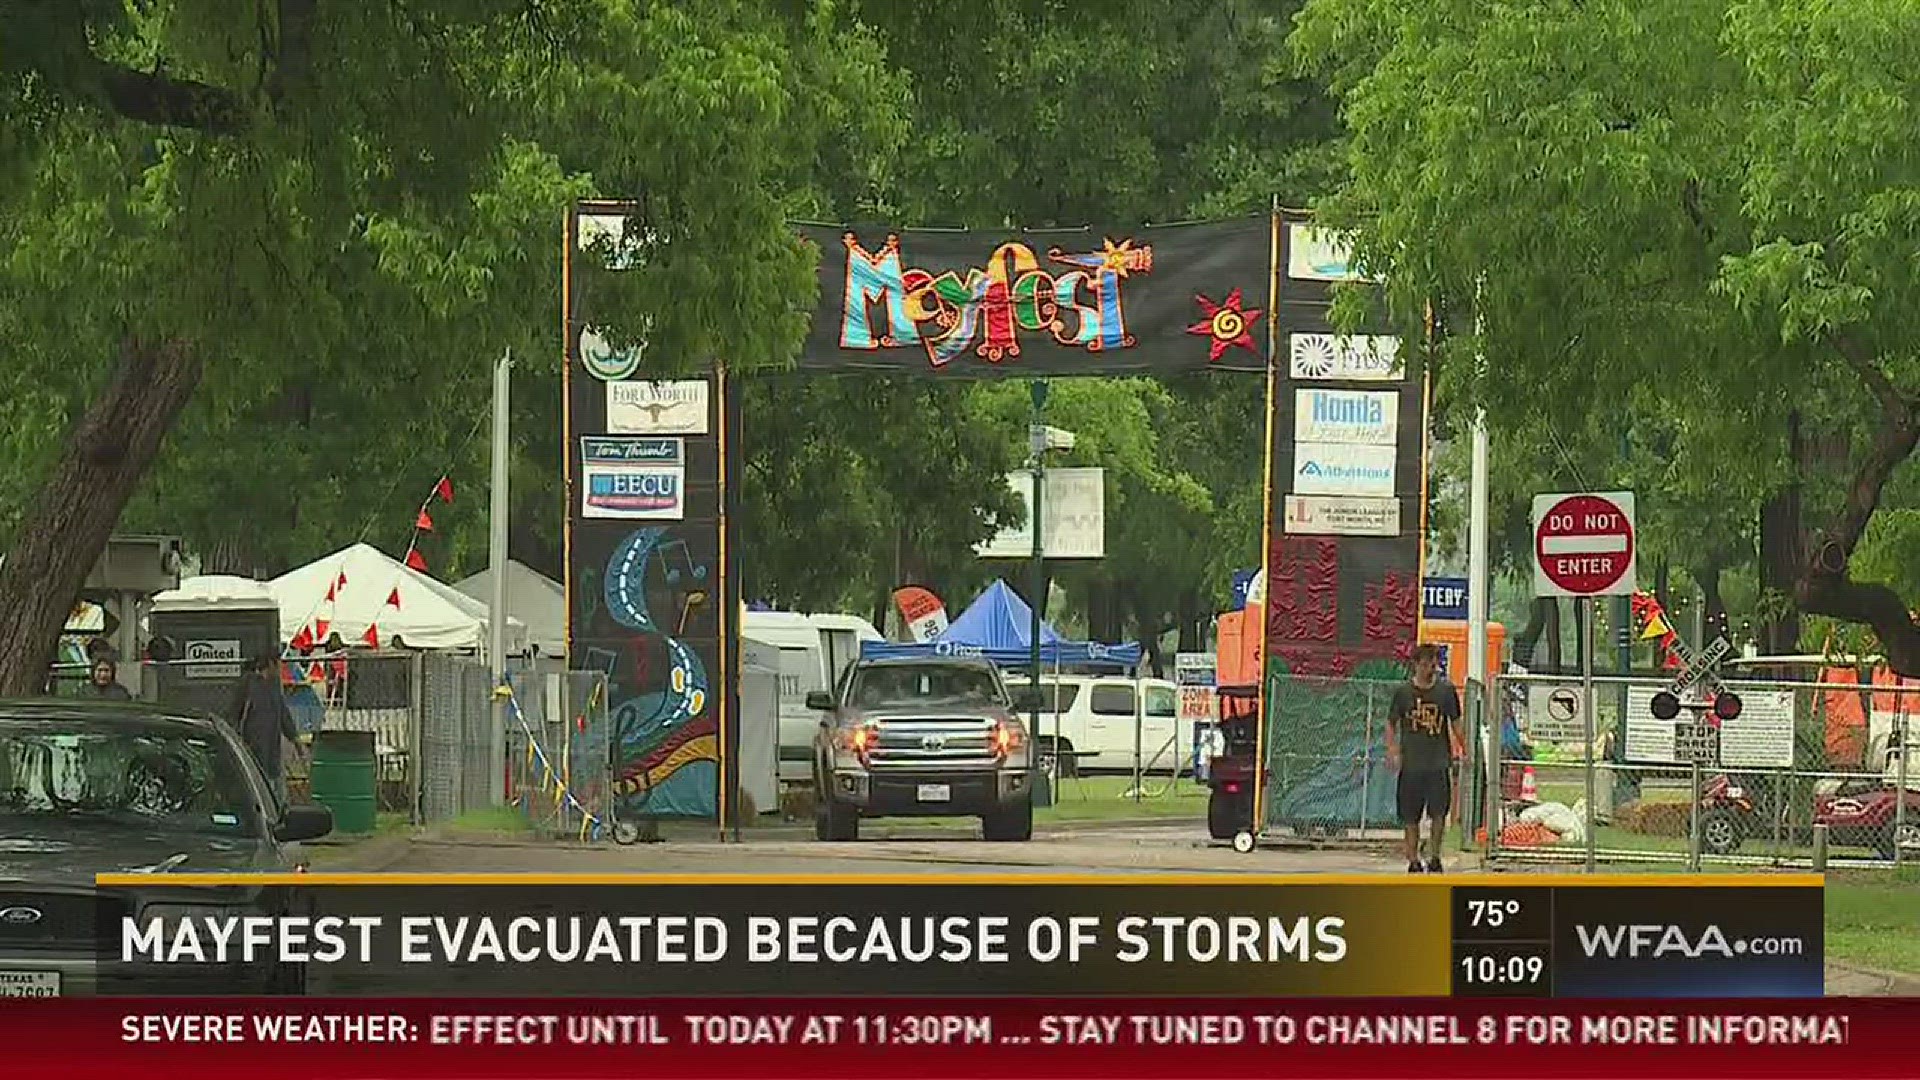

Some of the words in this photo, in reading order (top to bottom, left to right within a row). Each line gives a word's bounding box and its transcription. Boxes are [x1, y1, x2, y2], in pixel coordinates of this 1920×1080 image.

[840, 231, 1153, 366] Mayfest
[1312, 391, 1382, 423] Honda
[612, 473, 673, 495] EECU
[1549, 514, 1574, 531] DO
[1584, 513, 1620, 530] NOT
[1557, 558, 1613, 575] ENTER
[192, 647, 235, 660] United
[1671, 640, 1727, 694] CROSSING
[1677, 726, 1717, 738] STOP
